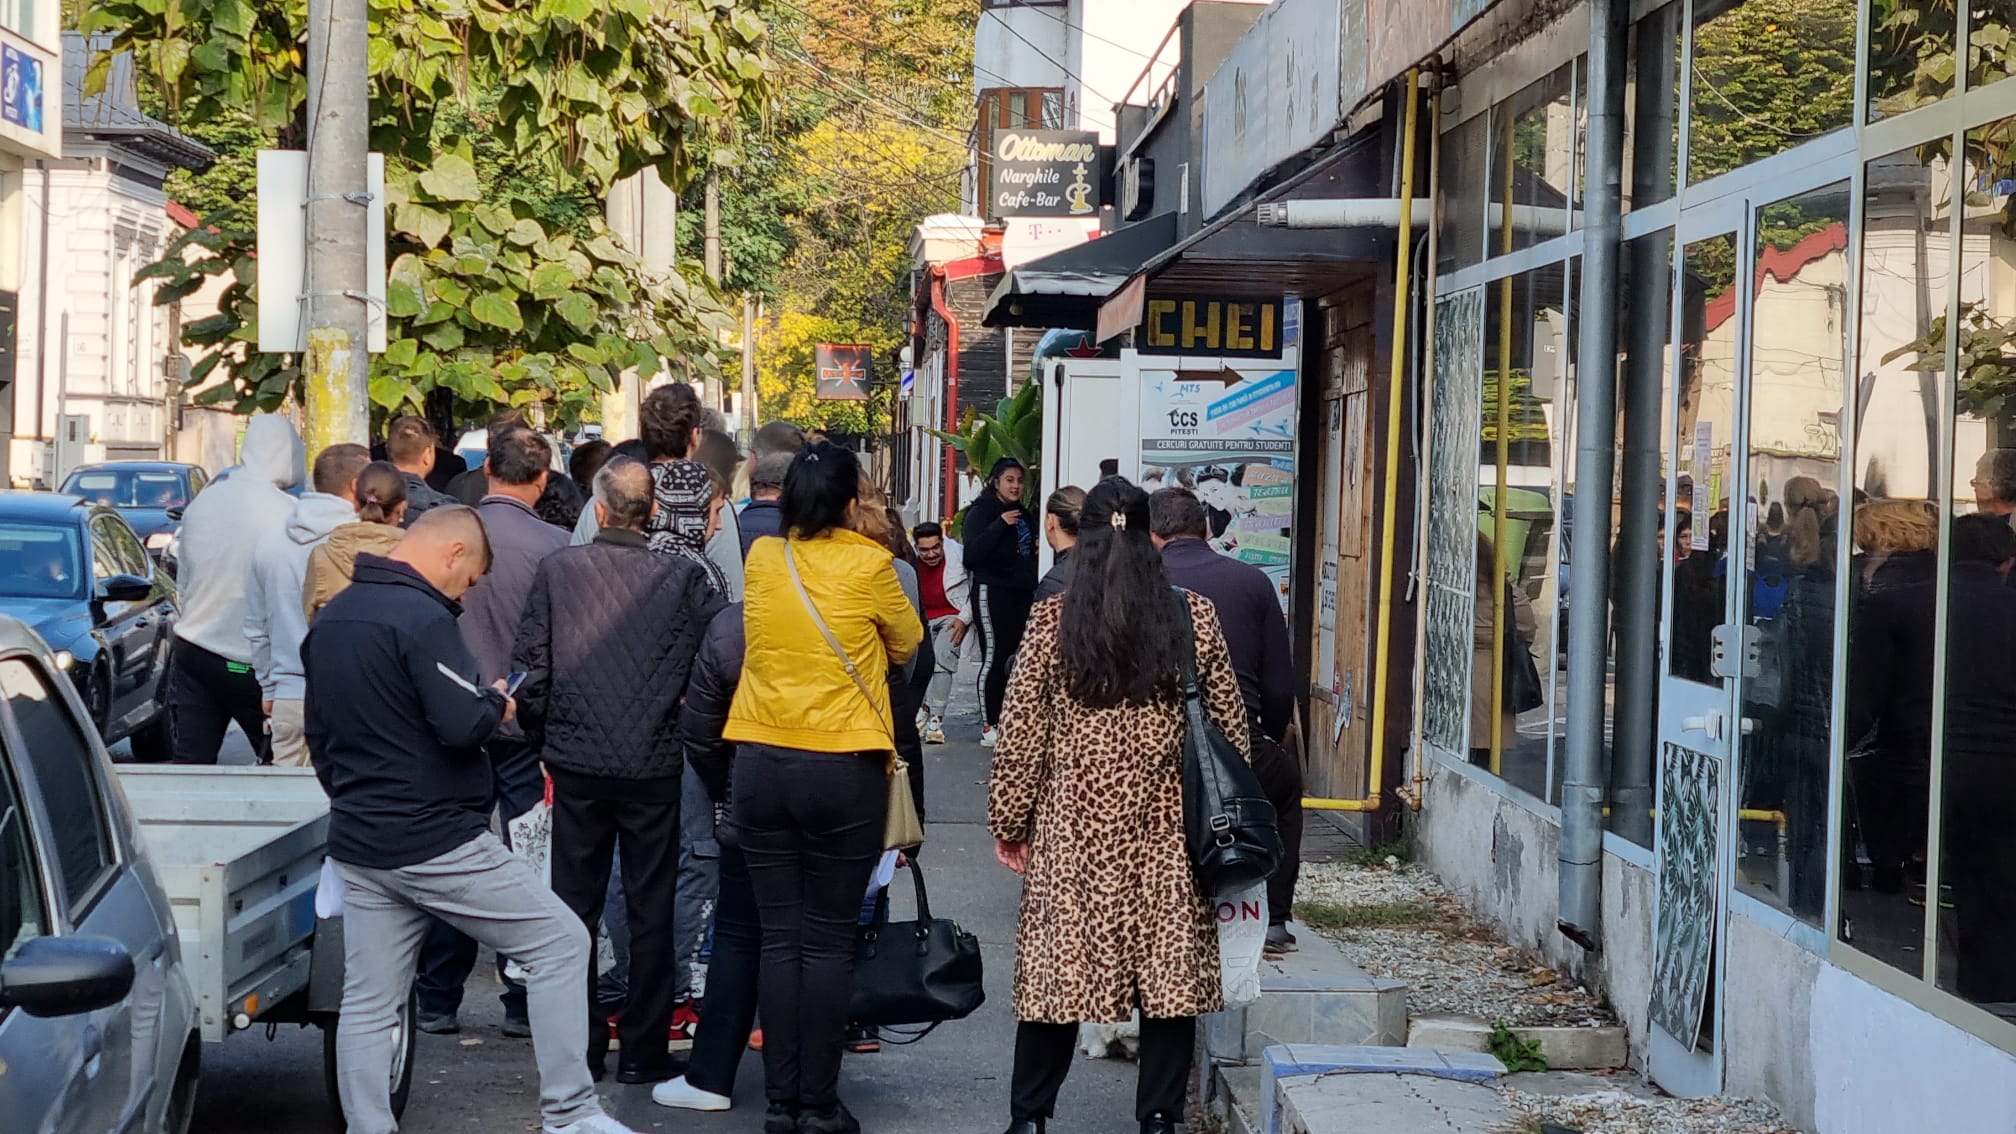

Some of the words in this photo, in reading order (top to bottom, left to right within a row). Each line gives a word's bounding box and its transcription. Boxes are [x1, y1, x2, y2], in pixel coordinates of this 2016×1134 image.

[1000, 135, 1095, 162] Ottoman
[999, 168, 1060, 188] Narghile
[999, 191, 1061, 208] Cafe-Bar
[1148, 300, 1274, 351] CHEI
[1180, 383, 1200, 393] MTS
[1170, 412, 1198, 427] CCS
[1157, 440, 1187, 449] CERCURI
[1188, 441, 1223, 449] GRATUITE
[1225, 441, 1253, 449] PENTRU
